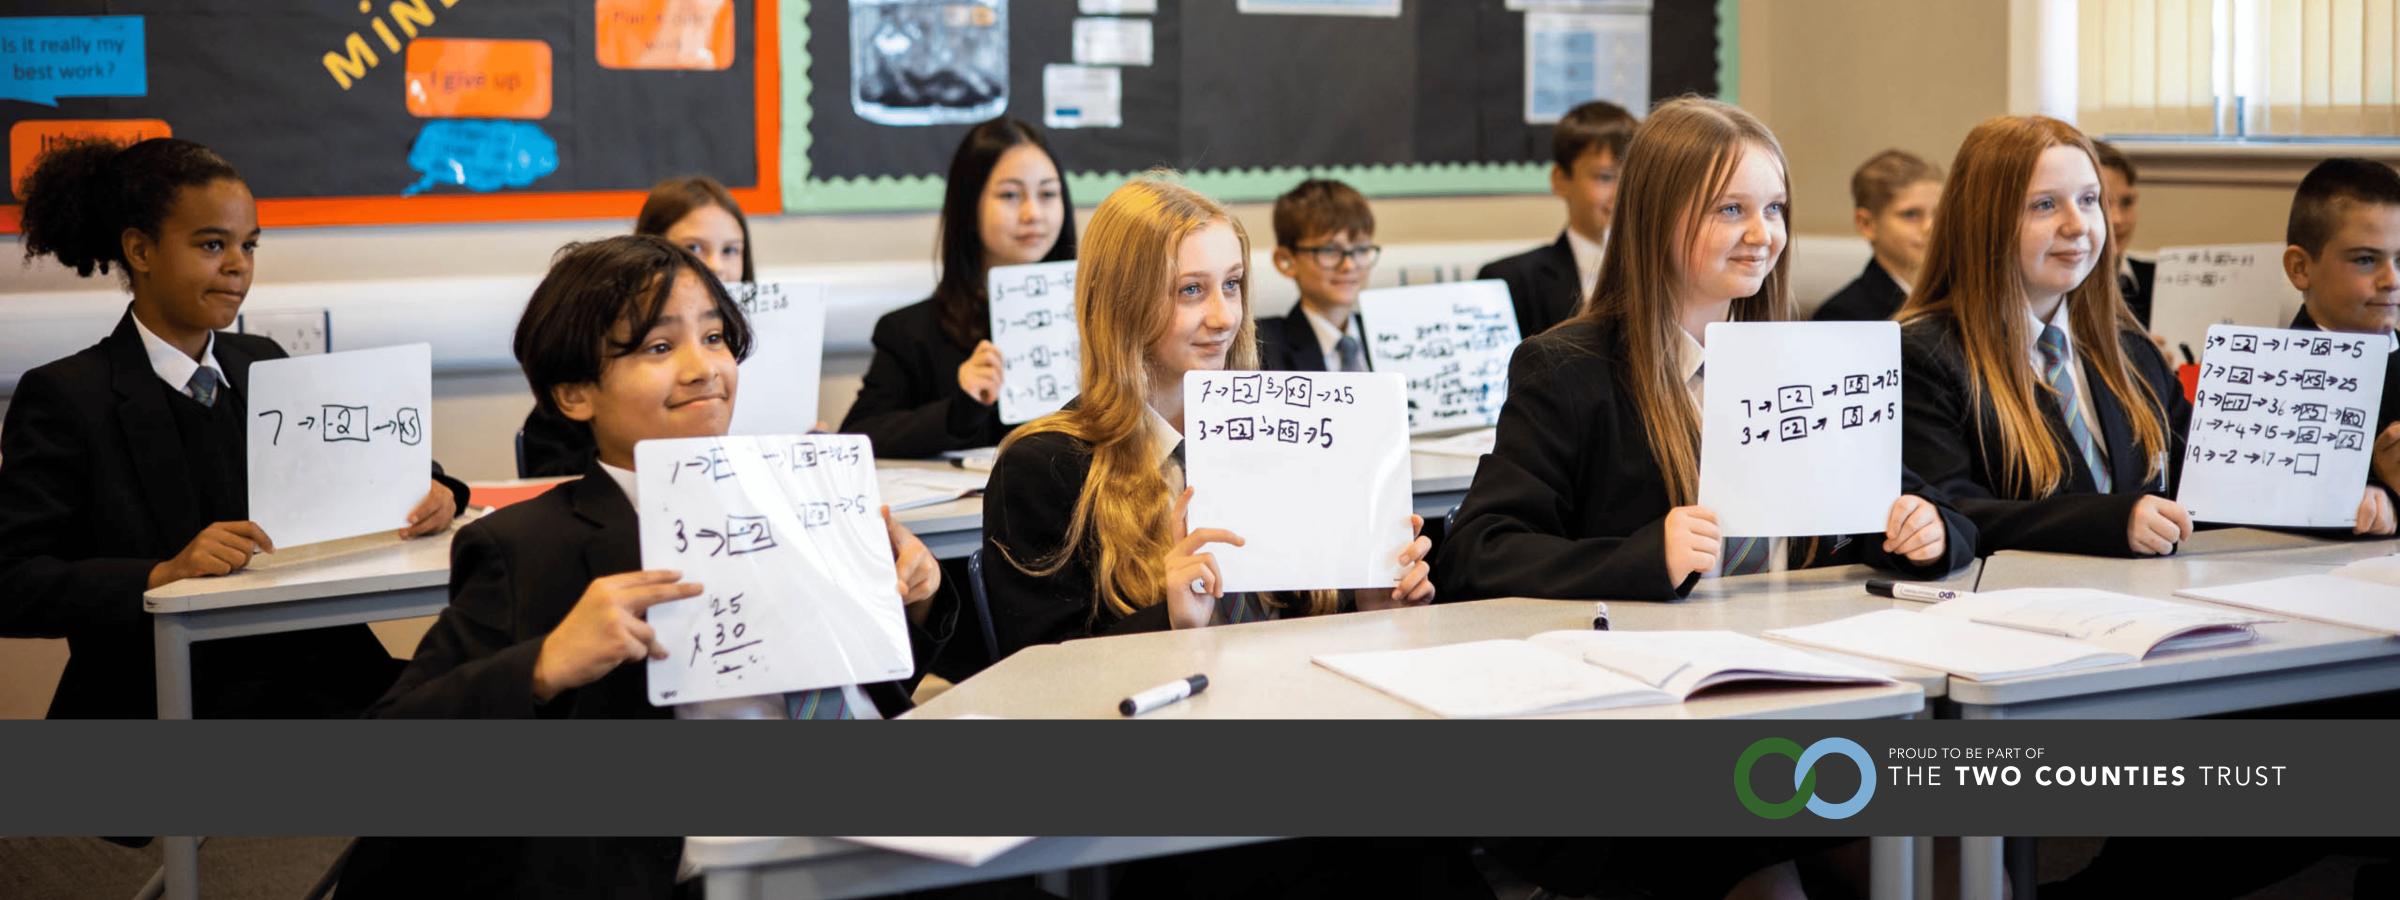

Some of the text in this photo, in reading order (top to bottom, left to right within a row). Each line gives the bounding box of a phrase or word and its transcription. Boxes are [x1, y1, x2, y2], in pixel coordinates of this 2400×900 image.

[1, 36, 126, 56] Is it really my
[13, 61, 117, 80] best work?
[444, 71, 487, 92] give
[495, 75, 522, 92] up
[2351, 340, 2366, 358] 5
[2203, 363, 2213, 379] 7
[2275, 370, 2289, 387] 5
[2337, 377, 2358, 392] 25
[1202, 380, 1212, 403] 7
[1234, 383, 1253, 398] -2
[1334, 386, 1355, 404] 25
[1741, 399, 1751, 418] 7
[1786, 390, 1804, 403] -2
[1886, 369, 1899, 387] 25
[2197, 389, 2205, 408] 9
[2267, 398, 2285, 416] 36
[259, 409, 283, 445] 7
[328, 407, 351, 434] -2
[1199, 420, 1207, 440] 3
[1230, 422, 1248, 437] -2
[1320, 417, 1334, 448] 5
[1741, 426, 1751, 445] 3
[1785, 422, 1802, 435] -2
[1887, 402, 1895, 420] 5
[2265, 425, 2279, 439] 15
[2186, 444, 2276, 466] 19 -2 17
[675, 519, 688, 553] 3
[710, 592, 745, 617] 25
[715, 622, 746, 646] 30
